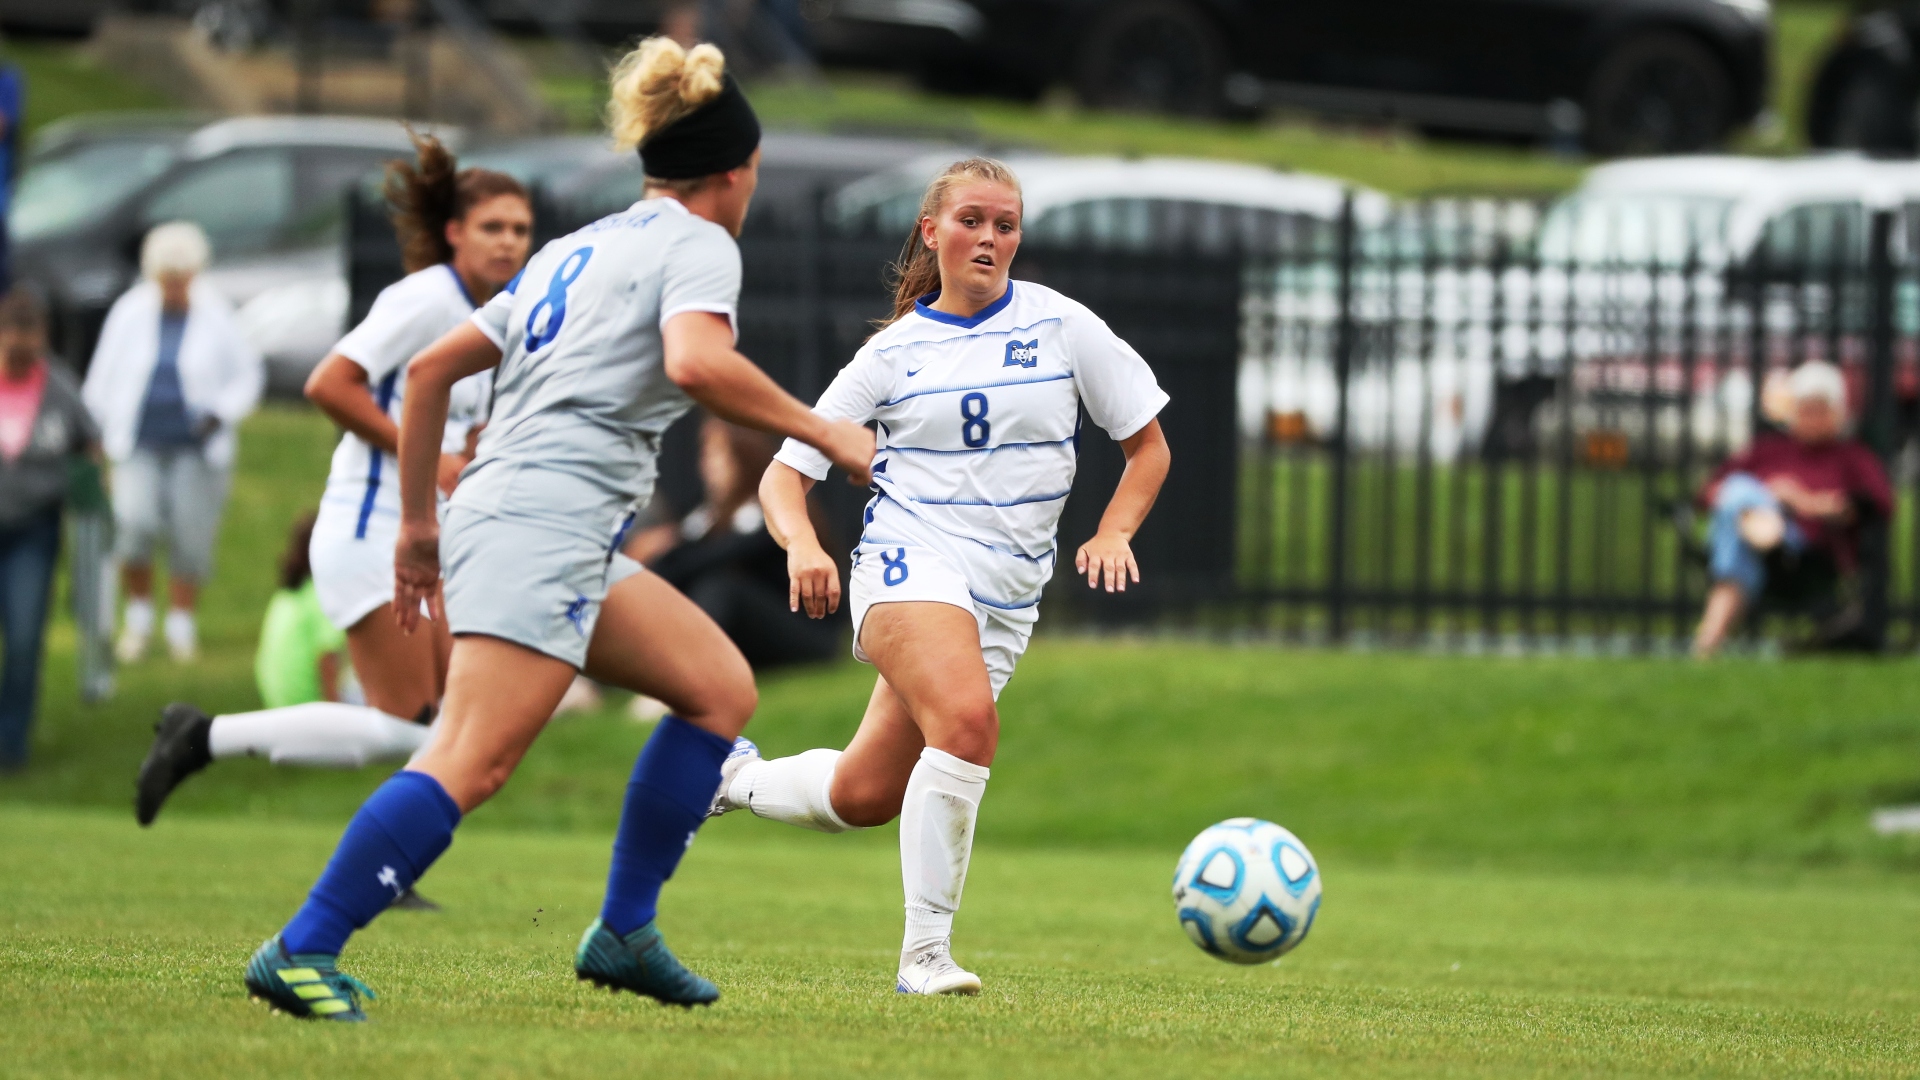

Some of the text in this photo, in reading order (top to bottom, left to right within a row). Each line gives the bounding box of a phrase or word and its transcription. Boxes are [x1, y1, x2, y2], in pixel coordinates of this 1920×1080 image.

[525, 246, 594, 353] 8
[961, 392, 990, 448] 8
[880, 547, 908, 587] 8
